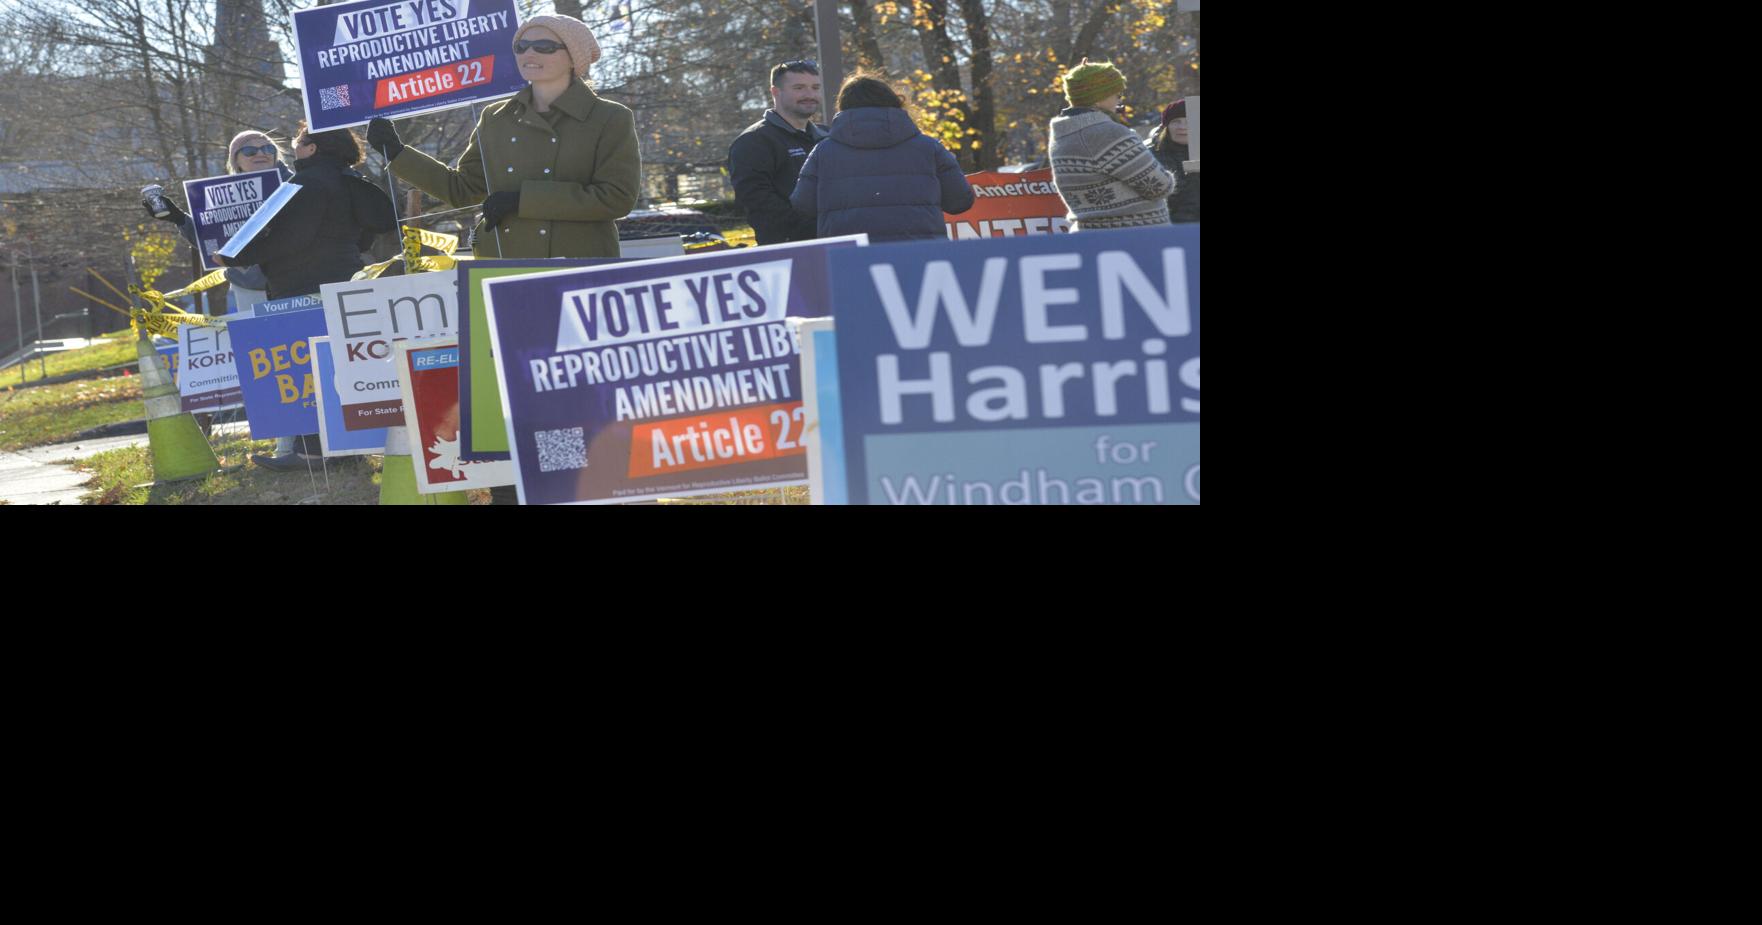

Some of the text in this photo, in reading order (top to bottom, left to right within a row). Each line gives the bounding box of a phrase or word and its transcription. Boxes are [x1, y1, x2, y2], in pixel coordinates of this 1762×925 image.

[317, 10, 509, 69] REPRODUCTIVE LIBERTY
[343, 0, 457, 40] VOTE YES
[367, 41, 470, 80] AMENDMENT
[388, 61, 485, 103] Article 22
[207, 180, 258, 207] VOTE YES
[200, 203, 254, 226] REPRODUCTIVE
[263, 302, 289, 313] Your
[573, 269, 767, 342] VOTE YES
[869, 247, 1192, 350] WEN
[248, 340, 310, 380] BEC
[416, 353, 459, 366] RE-EL
[530, 330, 740, 393] REPRODUCTIVE
[358, 409, 373, 417] For
[375, 407, 398, 415] State
[615, 364, 792, 422] AMENDMENT
[652, 417, 764, 469] Article
[1096, 435, 1158, 464] for
[880, 468, 1164, 504] Windham
